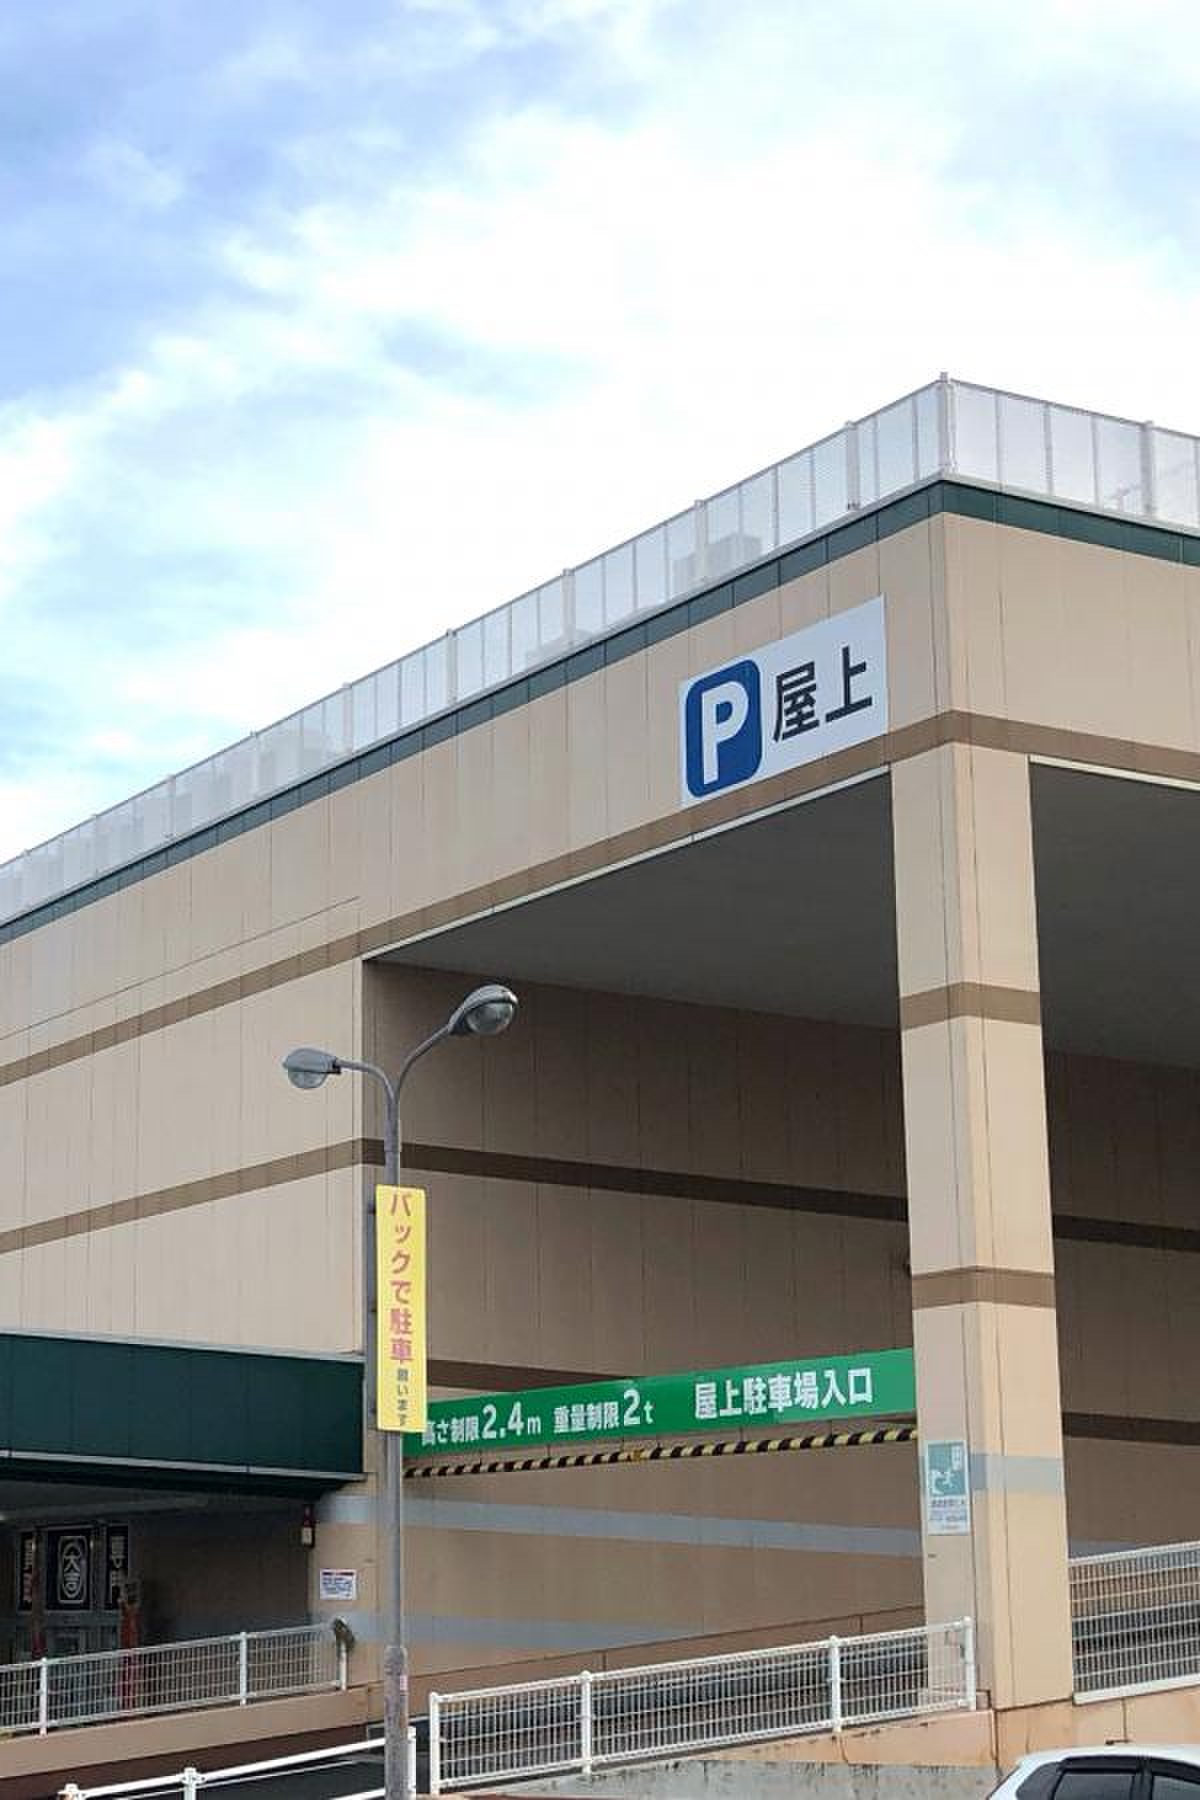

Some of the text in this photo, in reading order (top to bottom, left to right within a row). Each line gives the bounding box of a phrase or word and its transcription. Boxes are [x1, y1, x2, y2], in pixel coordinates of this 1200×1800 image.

[702, 646, 873, 785] P 屋上
[695, 1367, 873, 1419] 屋上駐車場入口
